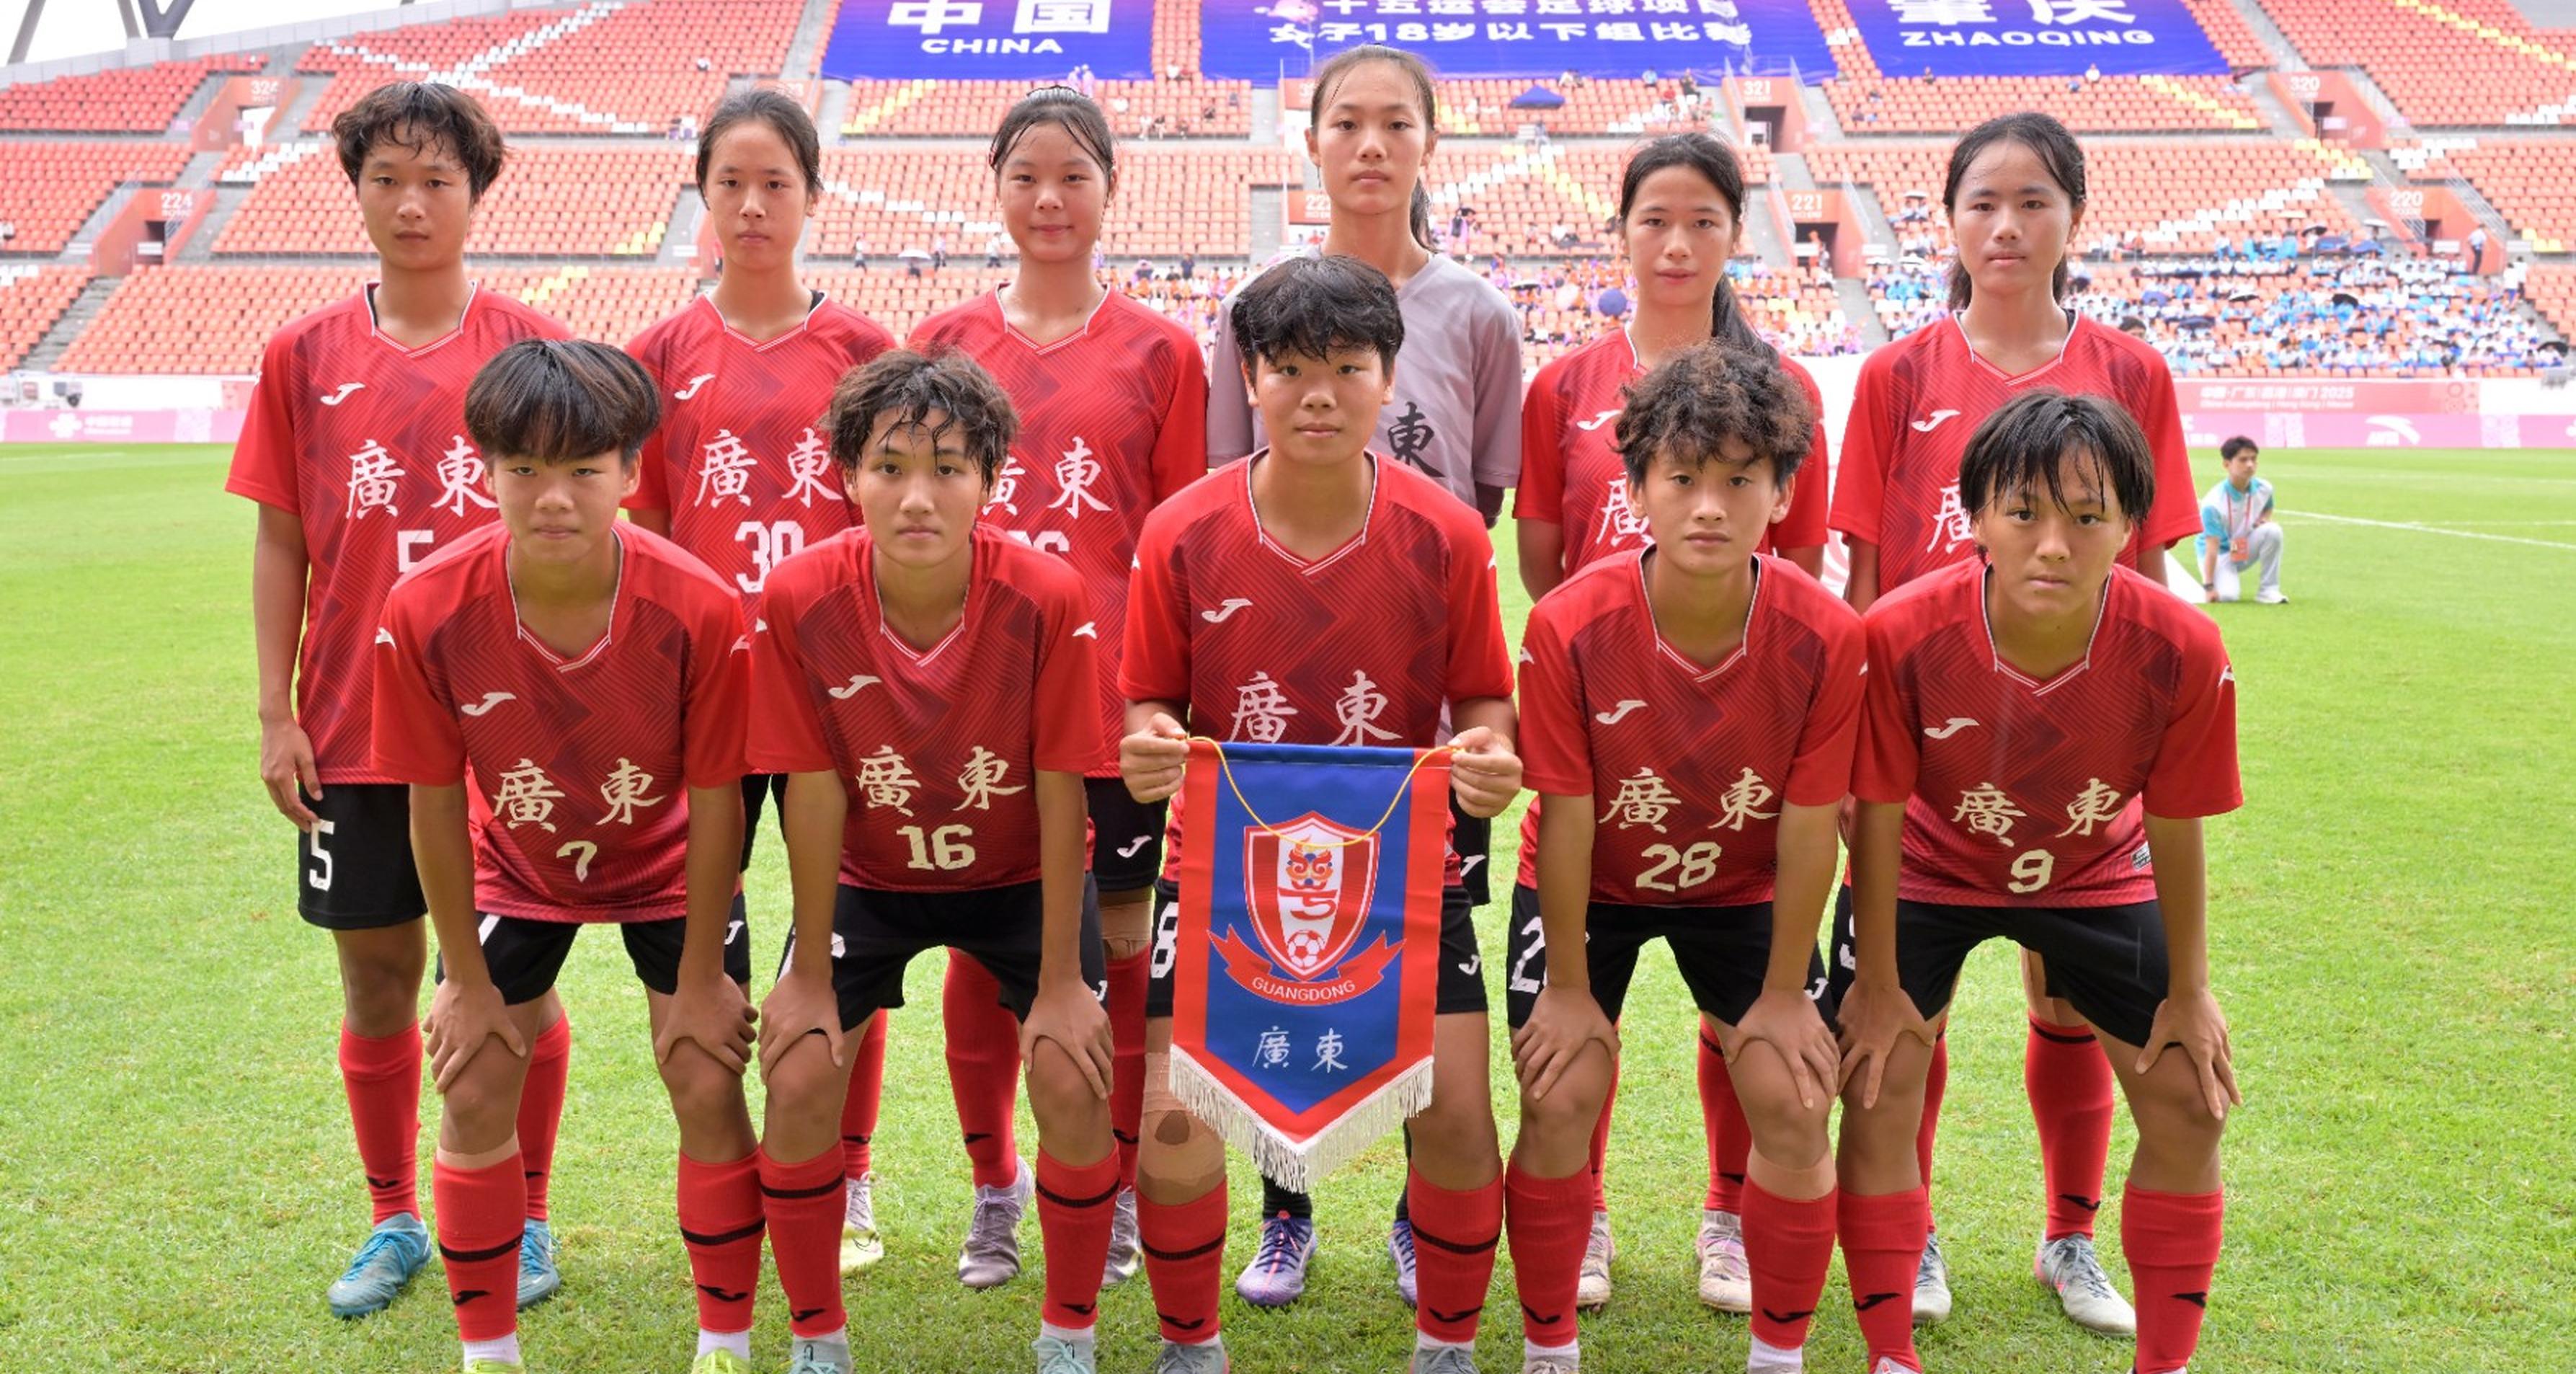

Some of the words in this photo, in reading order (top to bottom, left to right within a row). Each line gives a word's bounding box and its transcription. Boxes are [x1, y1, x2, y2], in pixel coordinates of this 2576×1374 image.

[887, 0, 1112, 34] 中国
[1899, 30, 2155, 47] ZHAOQING
[920, 38, 1063, 54] CHINA
[1744, 81, 1771, 95] 321
[2290, 76, 2320, 91] 320
[161, 192, 192, 209] 224
[1305, 195, 1331, 210] 22
[1791, 194, 1823, 210] 221
[2390, 191, 2422, 207] 220
[345, 435, 499, 520] 廣東
[693, 427, 843, 508] 廣東
[734, 520, 804, 593] 30
[1228, 670, 1404, 747] 廣東
[492, 758, 667, 833] 廣東
[856, 745, 1026, 817] 廣東
[1599, 767, 1778, 833] 廣東
[1951, 777, 2123, 848] 廣東
[309, 818, 334, 892] 5
[556, 841, 598, 882] 7
[897, 824, 975, 871] 16
[1635, 842, 1722, 892] 28
[2007, 848, 2054, 894] 9
[1509, 916, 1547, 994] 2
[1252, 977, 1356, 1001] GUANGDONG
[1252, 1025, 1349, 1073] 廣東
